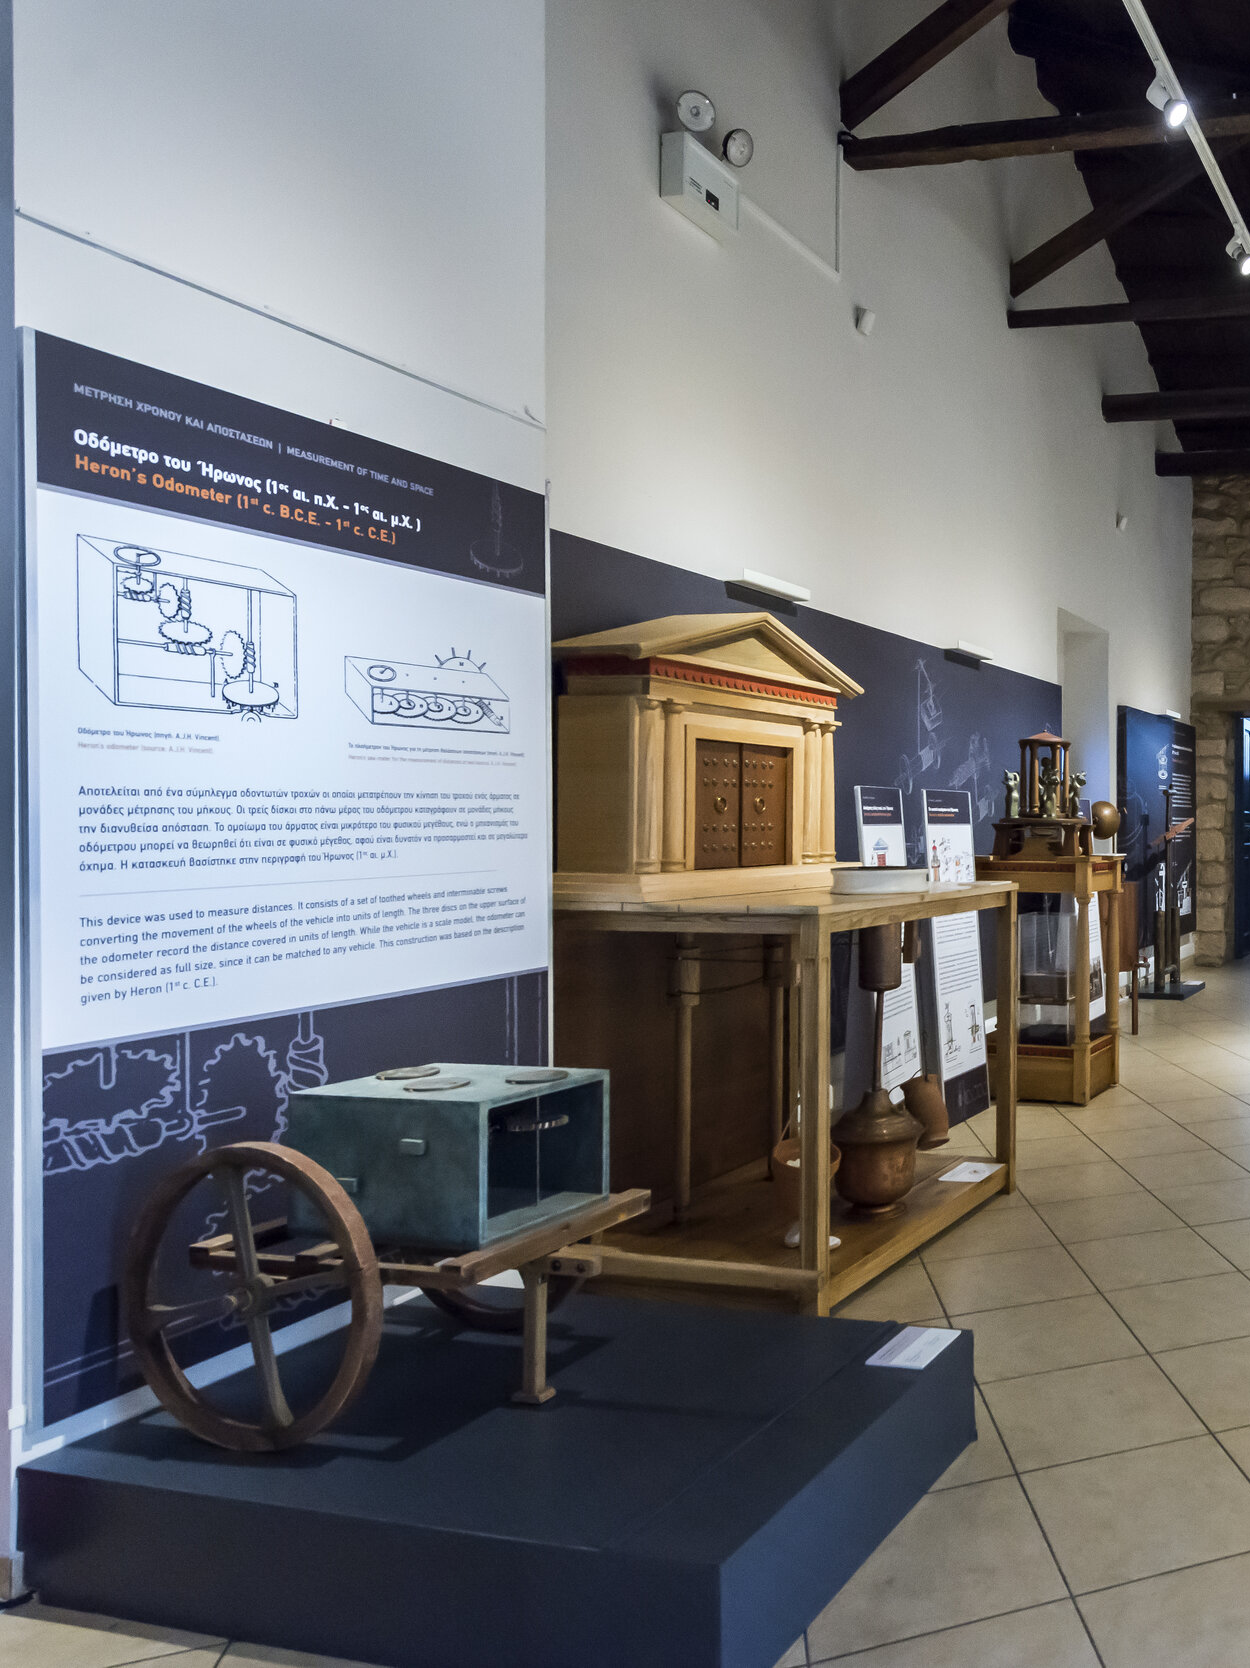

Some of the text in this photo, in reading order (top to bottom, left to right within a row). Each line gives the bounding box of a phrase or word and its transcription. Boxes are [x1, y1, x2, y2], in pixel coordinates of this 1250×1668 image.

[73, 382, 132, 408] ΜΕΤΡΗΣΗ
[135, 400, 182, 422] ΧΡΟΝΟΥ
[185, 415, 203, 429] ΚΑΙ
[206, 422, 273, 449] ΑΠΟΣΤΑΣΕΩΝ
[286, 445, 355, 472] MEASUREMENT
[356, 466, 368, 476] OF
[369, 469, 389, 483] TIME
[390, 477, 408, 488] AND
[409, 482, 434, 496] SPACE
[73, 428, 159, 464] Οδόμετρο
[162, 454, 191, 472] του
[292, 489, 310, 503] αι.
[372, 509, 387, 522] αι.
[152, 473, 232, 504] Odometer
[279, 504, 320, 526] B.C.E.
[120, 859, 128, 869] Η
[131, 857, 186, 869] κατασκευή
[238, 856, 259, 864] στην
[261, 853, 306, 865] περιγραφή
[79, 916, 103, 927] This
[106, 915, 141, 925] device
[143, 913, 165, 922] was
[168, 909, 193, 920] used
[195, 909, 205, 918] to
[207, 907, 249, 917] measure
[251, 903, 295, 914] distances.
[297, 901, 303, 910] It
[305, 899, 338, 909] consists
[340, 897, 348, 906] of
[356, 896, 368, 905] set
[369, 895, 377, 904] of
[378, 893, 405, 903] toothed
[406, 891, 431, 900] wheels
[432, 890, 445, 898] and
[446, 888, 485, 897] interminable
[486, 886, 507, 894] screws
[79, 933, 138, 947] converting
[141, 930, 158, 941] the
[161, 925, 214, 939] movement
[216, 923, 226, 934] of
[228, 923, 243, 933] the
[245, 919, 277, 931] wheels
[279, 918, 288, 928] of
[290, 917, 303, 927] the
[305, 914, 333, 925] vehicle
[335, 913, 350, 922] into
[352, 911, 371, 921] units
[372, 910, 380, 919] of
[381, 908, 406, 919] length.
[407, 906, 420, 915] The
[421, 905, 440, 914] three
[440, 904, 457, 912] discs
[479, 901, 496, 909] upper
[497, 898, 519, 906] surface
[519, 896, 526, 904] of
[80, 992, 111, 1006] given
[114, 988, 127, 1000] by
[130, 985, 162, 997] Heron
